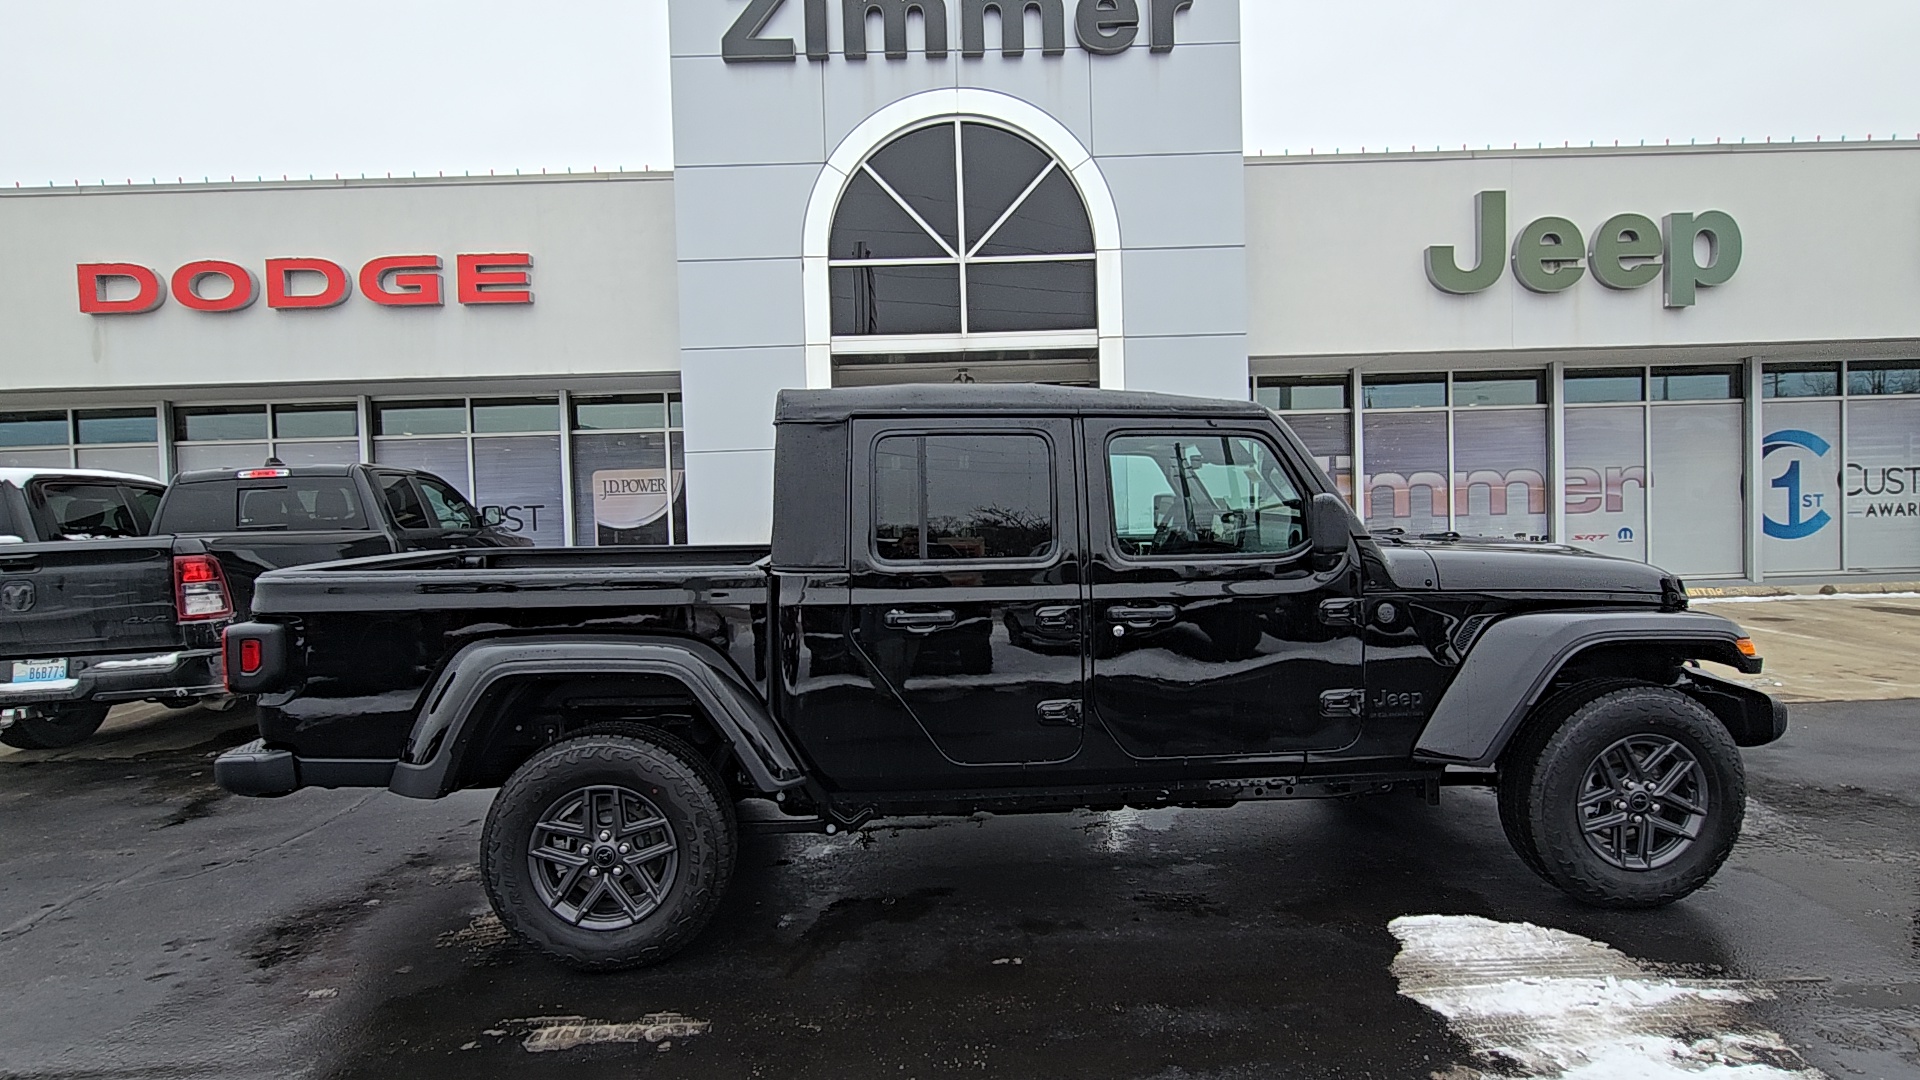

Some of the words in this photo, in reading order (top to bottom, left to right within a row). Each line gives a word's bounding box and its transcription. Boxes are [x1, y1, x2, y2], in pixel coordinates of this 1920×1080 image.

[721, 0, 1194, 63] Zimmer
[1423, 190, 1742, 309] Jeep
[76, 253, 535, 315] DODGE
[621, 478, 667, 493] POWER
[1313, 455, 1654, 519] immer
[1865, 502, 1920, 518] AWAR
[1571, 534, 1609, 542] SRT
[1686, 587, 1724, 596] SITOR
[1373, 689, 1422, 709] Jeep
